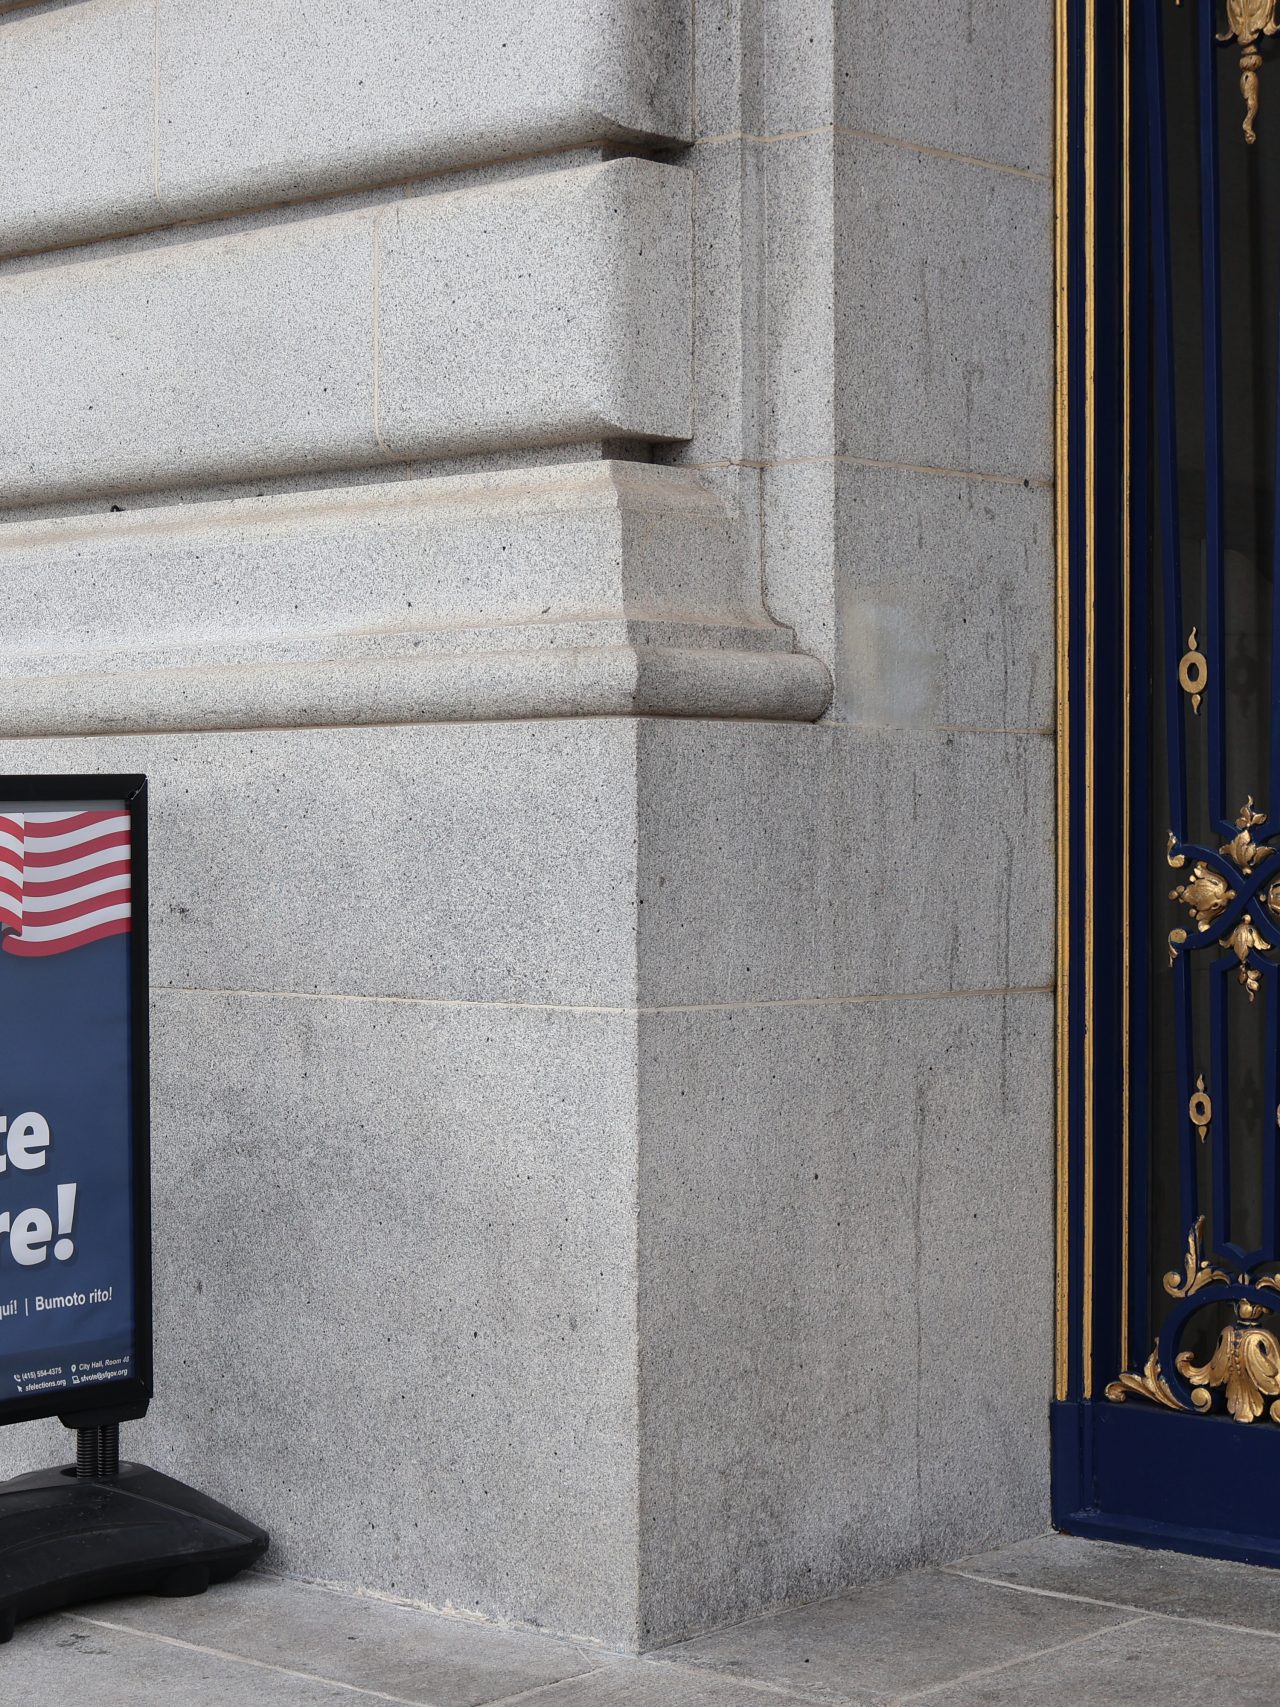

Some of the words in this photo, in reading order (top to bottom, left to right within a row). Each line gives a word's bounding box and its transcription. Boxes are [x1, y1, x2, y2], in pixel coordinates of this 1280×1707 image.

[35, 1292, 86, 1311] Bumoto
[89, 1286, 113, 1303] rito!
[79, 1363, 90, 1371] City
[105, 1358, 122, 1366] Room
[21, 1371, 37, 1381] (415)
[36, 1366, 62, 1378] 554-4375
[25, 1379, 67, 1391] sfelections.org
